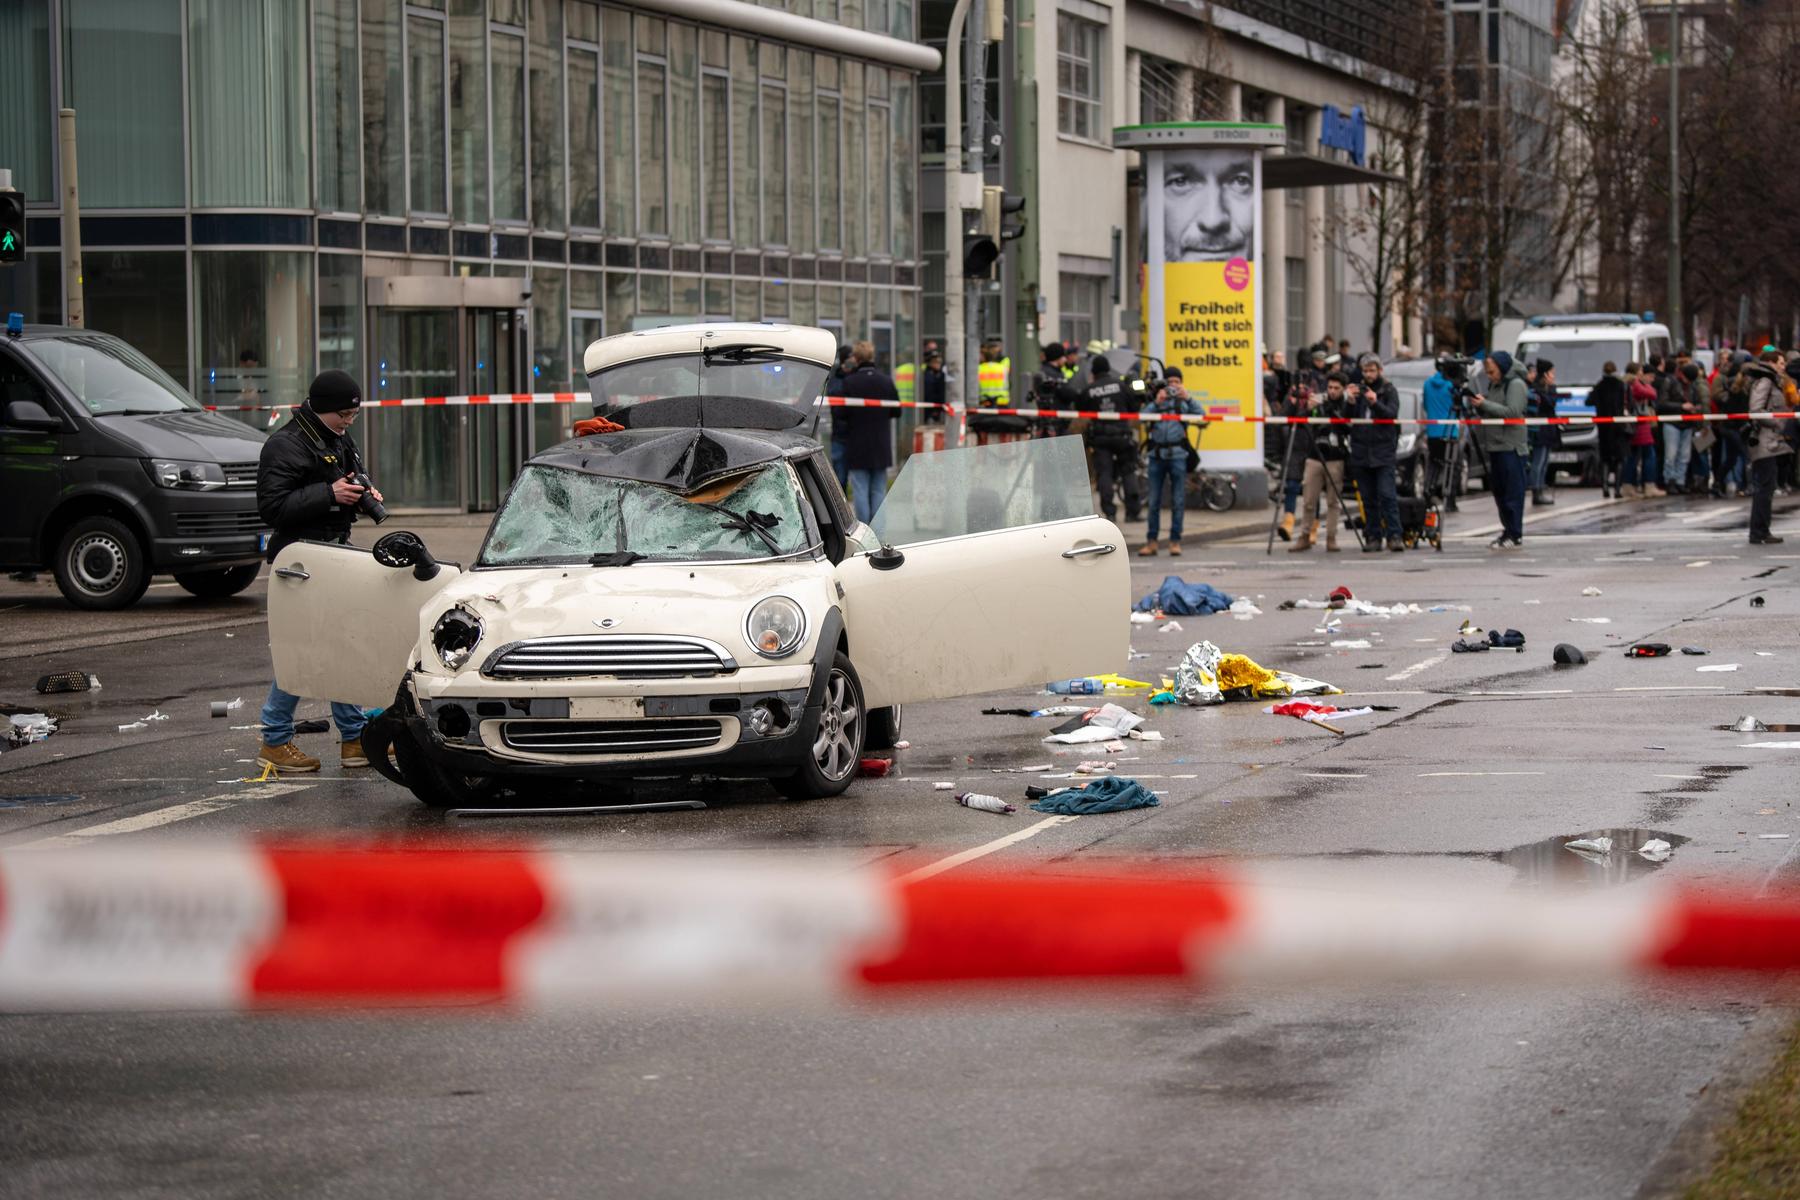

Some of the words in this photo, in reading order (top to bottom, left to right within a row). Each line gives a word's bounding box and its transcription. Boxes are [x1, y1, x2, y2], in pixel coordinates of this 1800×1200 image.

[1180, 302, 1244, 315] Freiheit
[1168, 319, 1218, 332] wählt
[1223, 320, 1252, 332] sich
[1173, 336, 1218, 349] nicht
[1223, 339, 1249, 349] von
[1183, 353, 1242, 367] selbst.
[1089, 383, 1120, 398] POLIZEI
